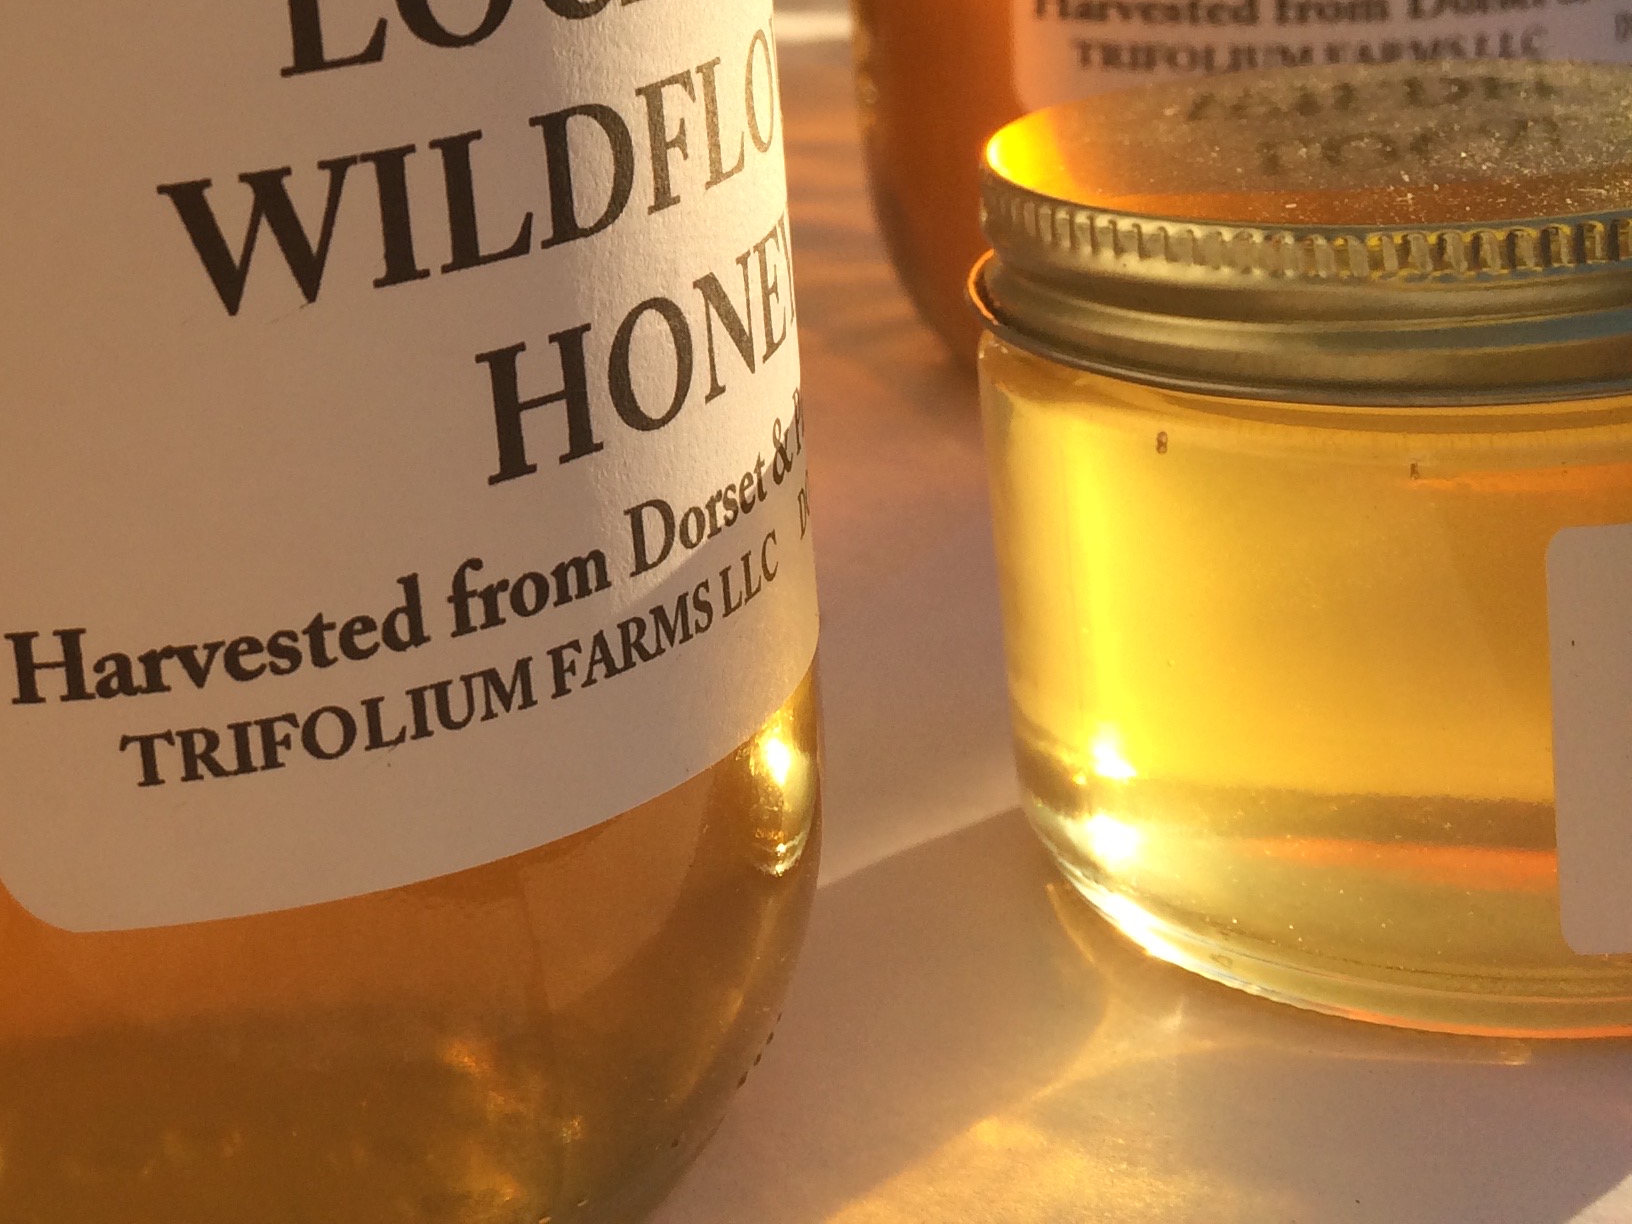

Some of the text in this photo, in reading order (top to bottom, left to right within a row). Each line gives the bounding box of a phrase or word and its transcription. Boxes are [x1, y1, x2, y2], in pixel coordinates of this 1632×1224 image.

[157, 17, 780, 316] WILDFLO
[475, 208, 795, 487] HONE
[5, 574, 431, 704] Harvested
[447, 556, 614, 640] from
[622, 452, 768, 577] Dorset
[772, 416, 794, 486] &
[120, 528, 780, 787] TRIFOLIUM FARMS LLC
